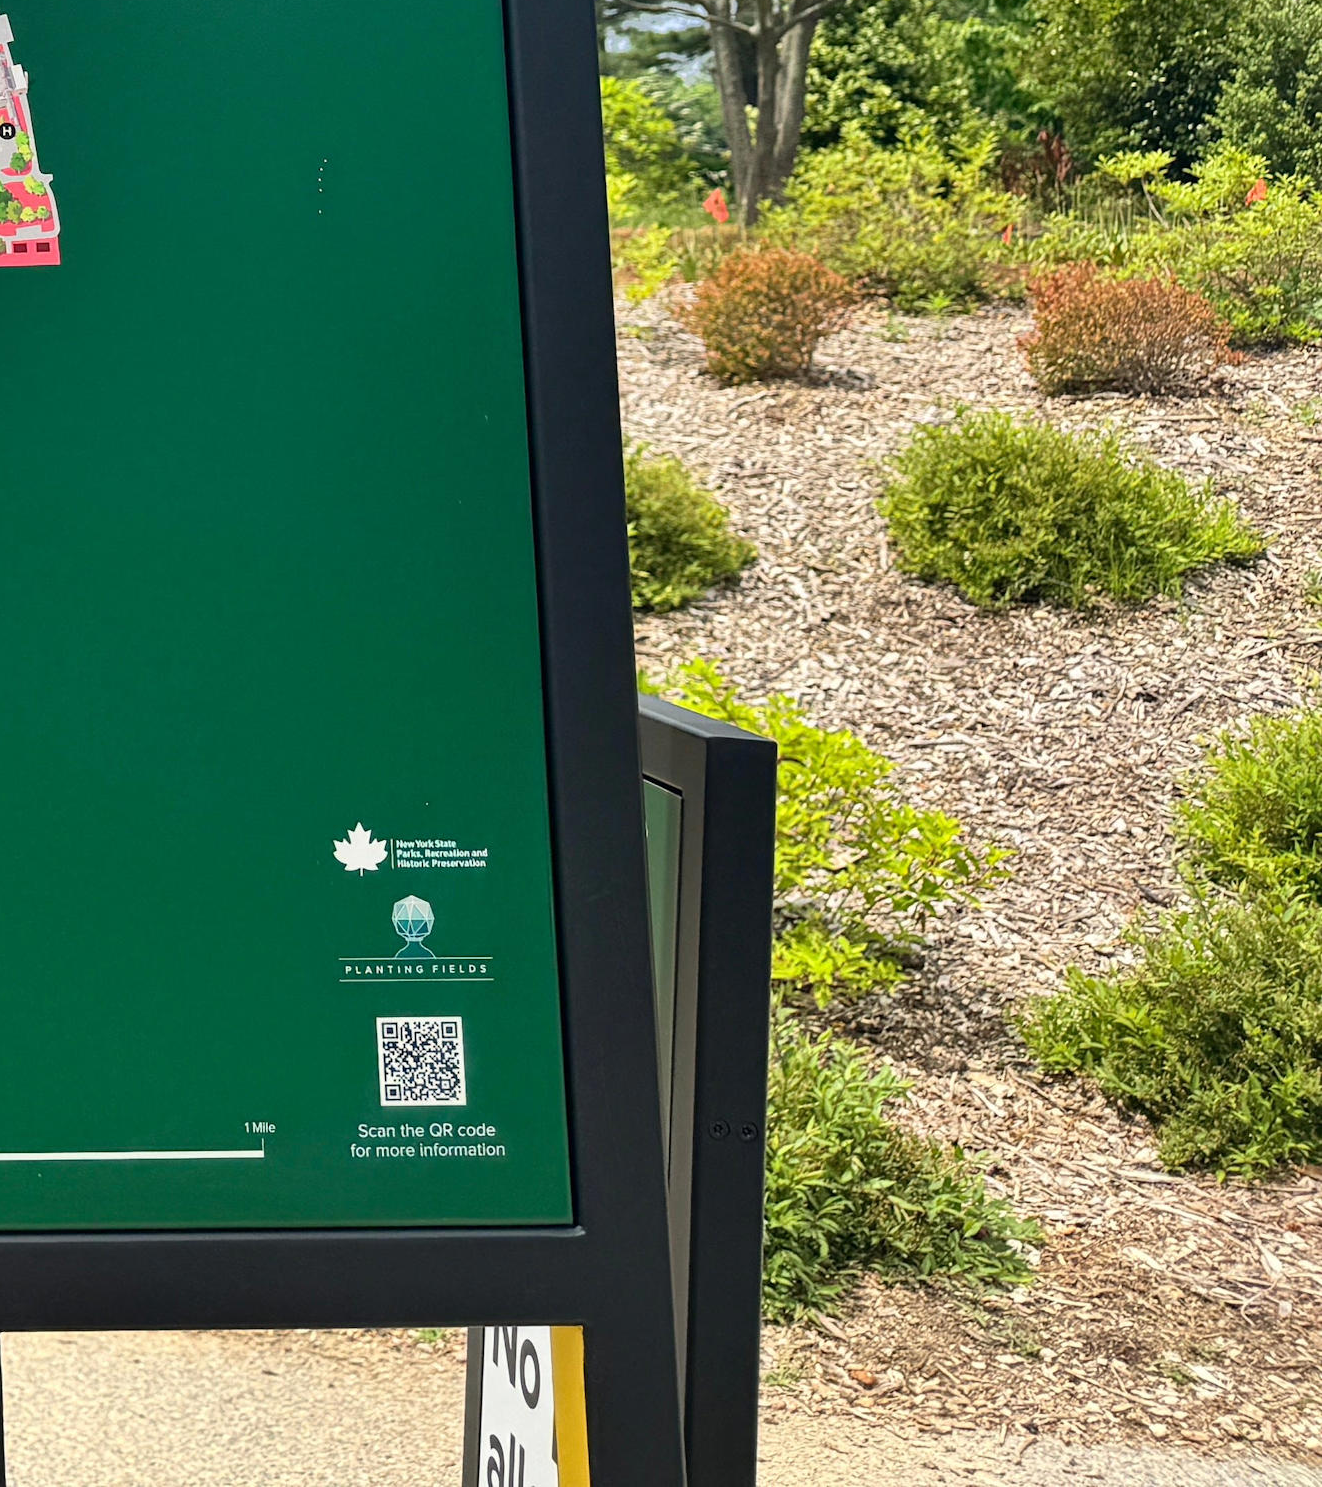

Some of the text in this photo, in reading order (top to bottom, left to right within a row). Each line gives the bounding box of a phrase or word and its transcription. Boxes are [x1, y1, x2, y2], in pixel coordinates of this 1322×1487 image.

[345, 964, 487, 975] PLANTING FIELDS
[244, 1121, 276, 1134] 1 Mile
[357, 1122, 496, 1138] Scan the QR code
[350, 1142, 506, 1158] for more information
